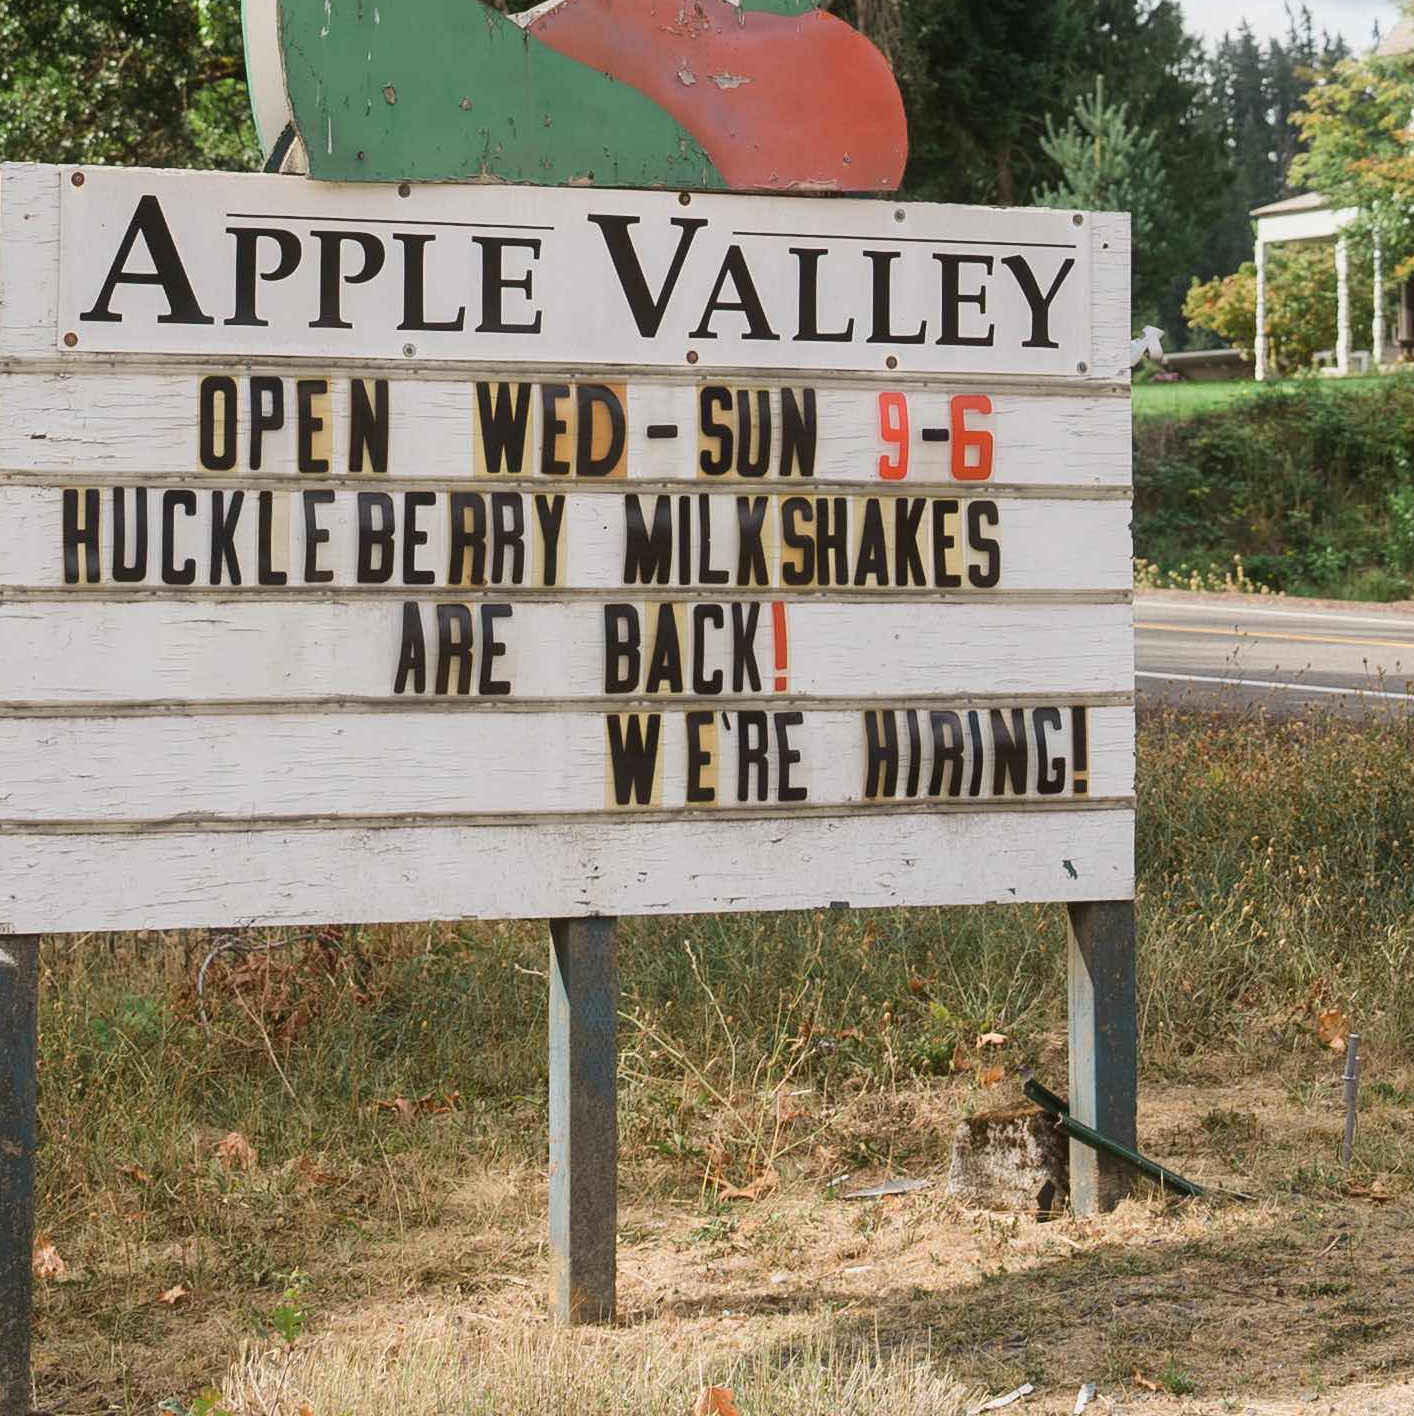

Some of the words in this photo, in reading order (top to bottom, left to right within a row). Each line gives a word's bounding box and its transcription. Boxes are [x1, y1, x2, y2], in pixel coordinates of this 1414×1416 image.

[80, 194, 543, 333] APPLE
[587, 213, 1075, 349] VALLEY
[199, 375, 389, 472] OPEN
[877, 392, 994, 481] 9-6
[63, 487, 566, 585] HUCKLEBERRY
[623, 493, 1001, 587] MILKSHAKES
[393, 601, 514, 695] ARE
[605, 601, 789, 693] BACK!
[607, 710, 809, 806] WE'RE
[863, 706, 1089, 797] HIRING!
